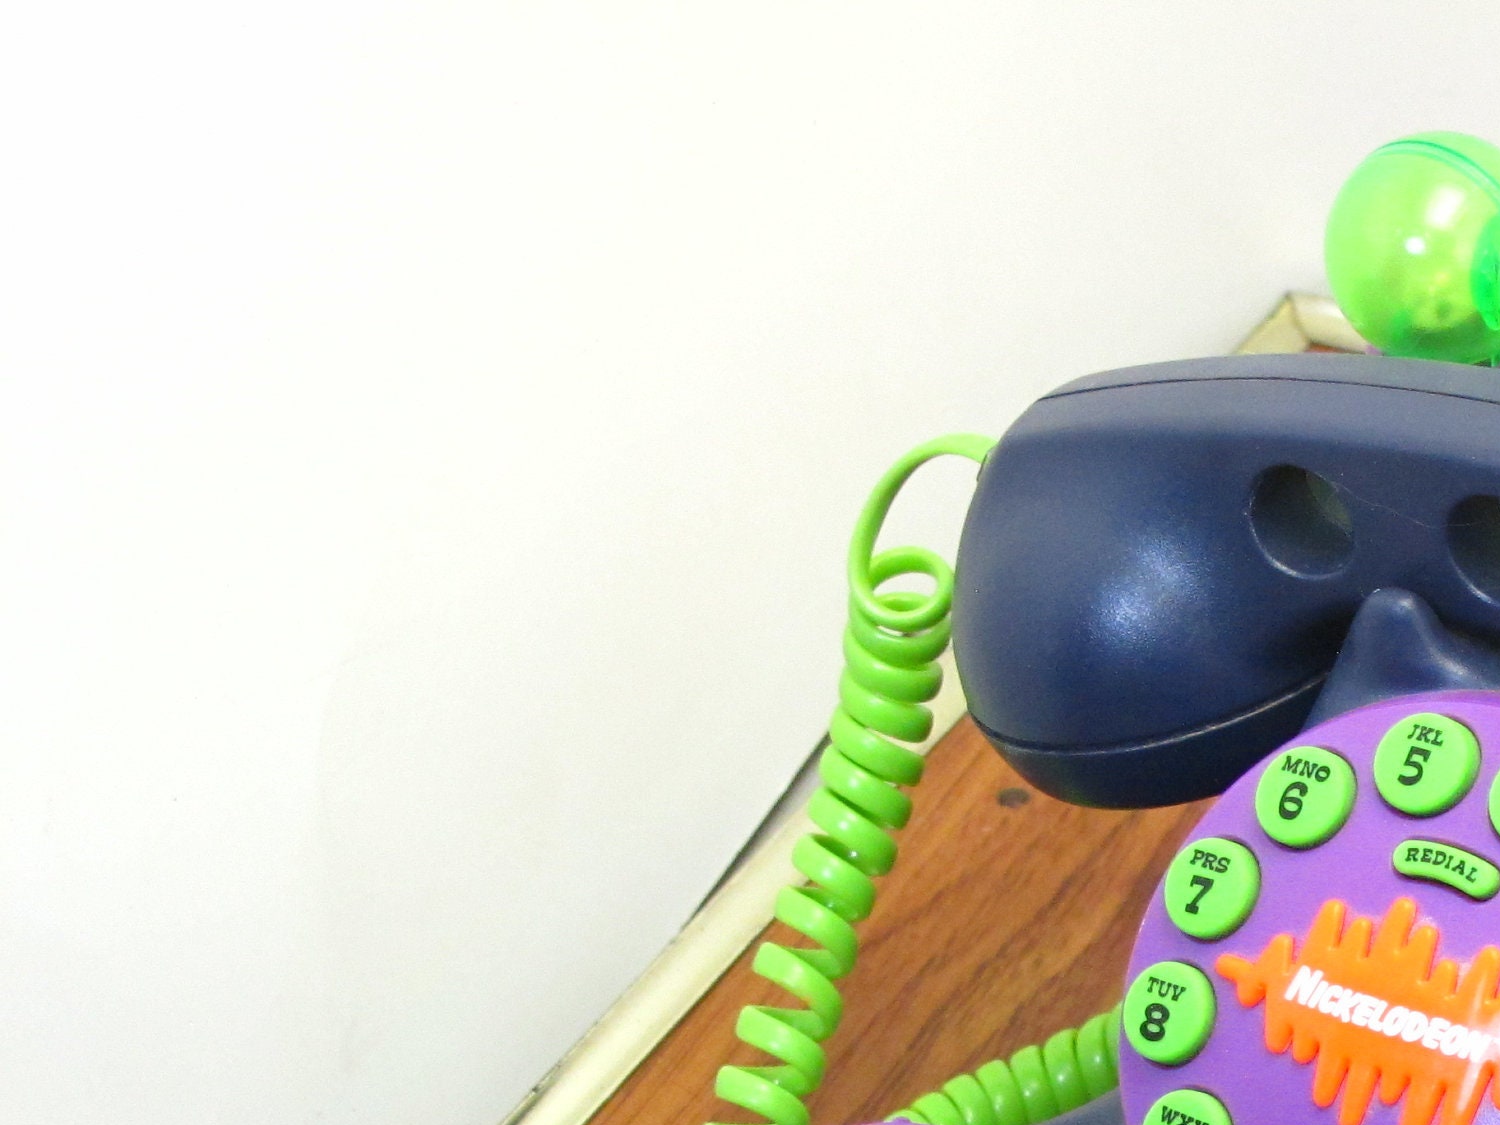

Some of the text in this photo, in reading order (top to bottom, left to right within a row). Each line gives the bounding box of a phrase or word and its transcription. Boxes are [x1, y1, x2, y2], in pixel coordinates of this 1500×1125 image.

[1407, 724, 1444, 747] JKL
[1281, 756, 1331, 782] MNO
[1397, 746, 1431, 786] 5
[1278, 782, 1309, 820] 6
[1190, 849, 1231, 874] PRS
[1405, 847, 1477, 883] REDIAL
[1184, 875, 1214, 915] 7
[1146, 976, 1186, 1001] TUV
[1139, 1002, 1170, 1042] 8
